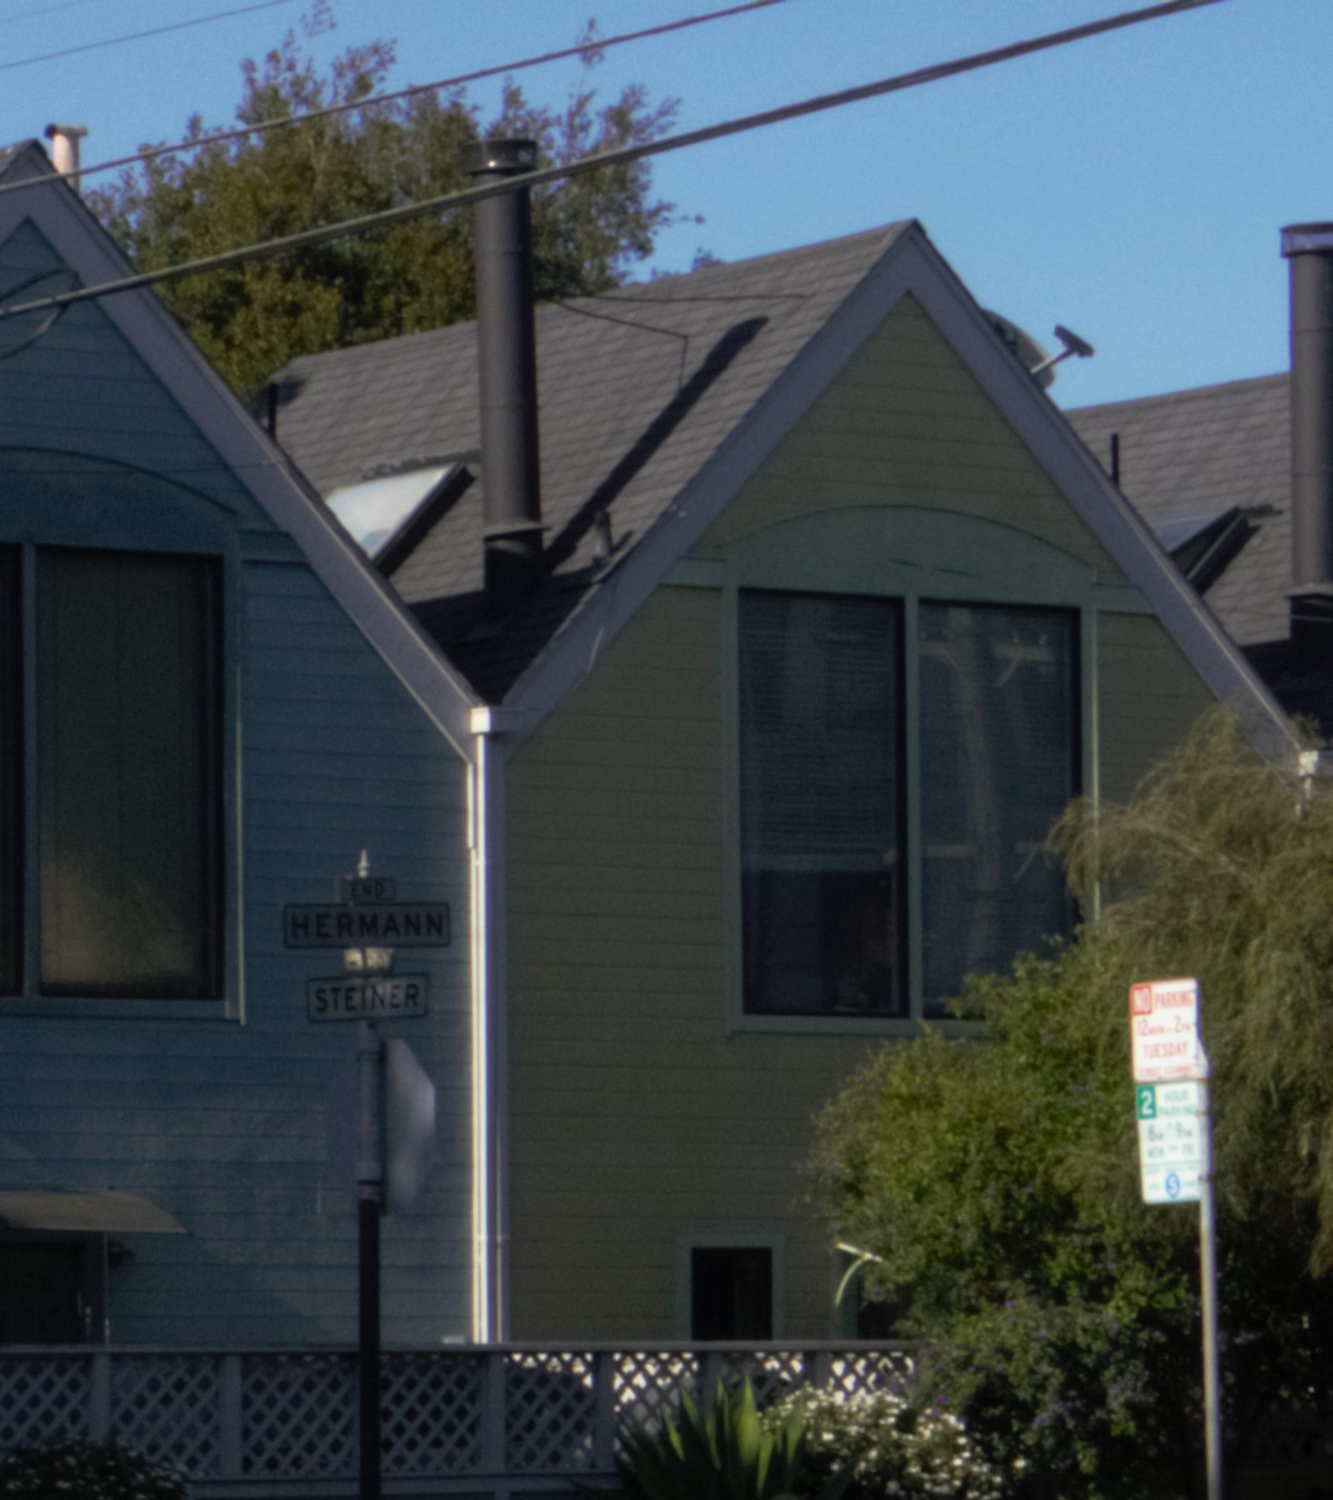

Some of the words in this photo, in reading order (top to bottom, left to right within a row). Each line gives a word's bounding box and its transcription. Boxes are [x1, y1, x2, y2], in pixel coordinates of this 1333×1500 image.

[291, 913, 443, 938] HERMANN
[315, 984, 421, 1013] STEINER
[1141, 1090, 1153, 1115] 2
